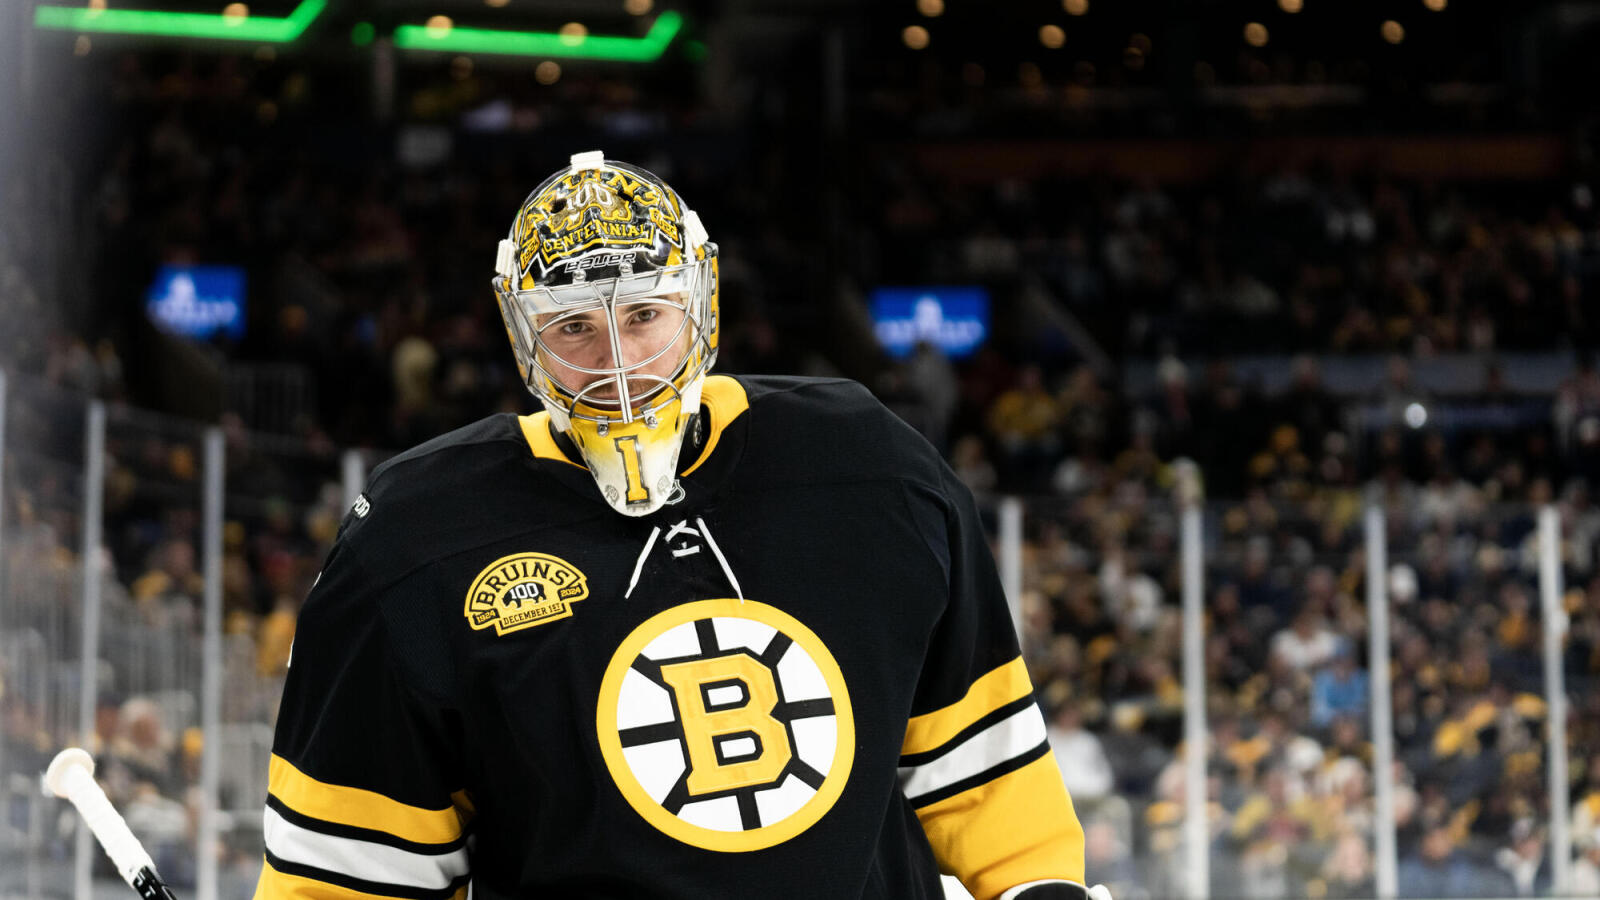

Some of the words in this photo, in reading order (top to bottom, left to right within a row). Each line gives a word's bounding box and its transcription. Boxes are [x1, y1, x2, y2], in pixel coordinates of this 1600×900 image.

[543, 220, 650, 252] CENTENNIAL
[565, 251, 637, 274] BAUER
[476, 561, 570, 606] BRUINS
[509, 582, 540, 600] 100
[561, 586, 581, 598] 2024
[503, 606, 548, 626] DECEMBER
[548, 602, 562, 615] 1ST
[660, 652, 793, 797] B
